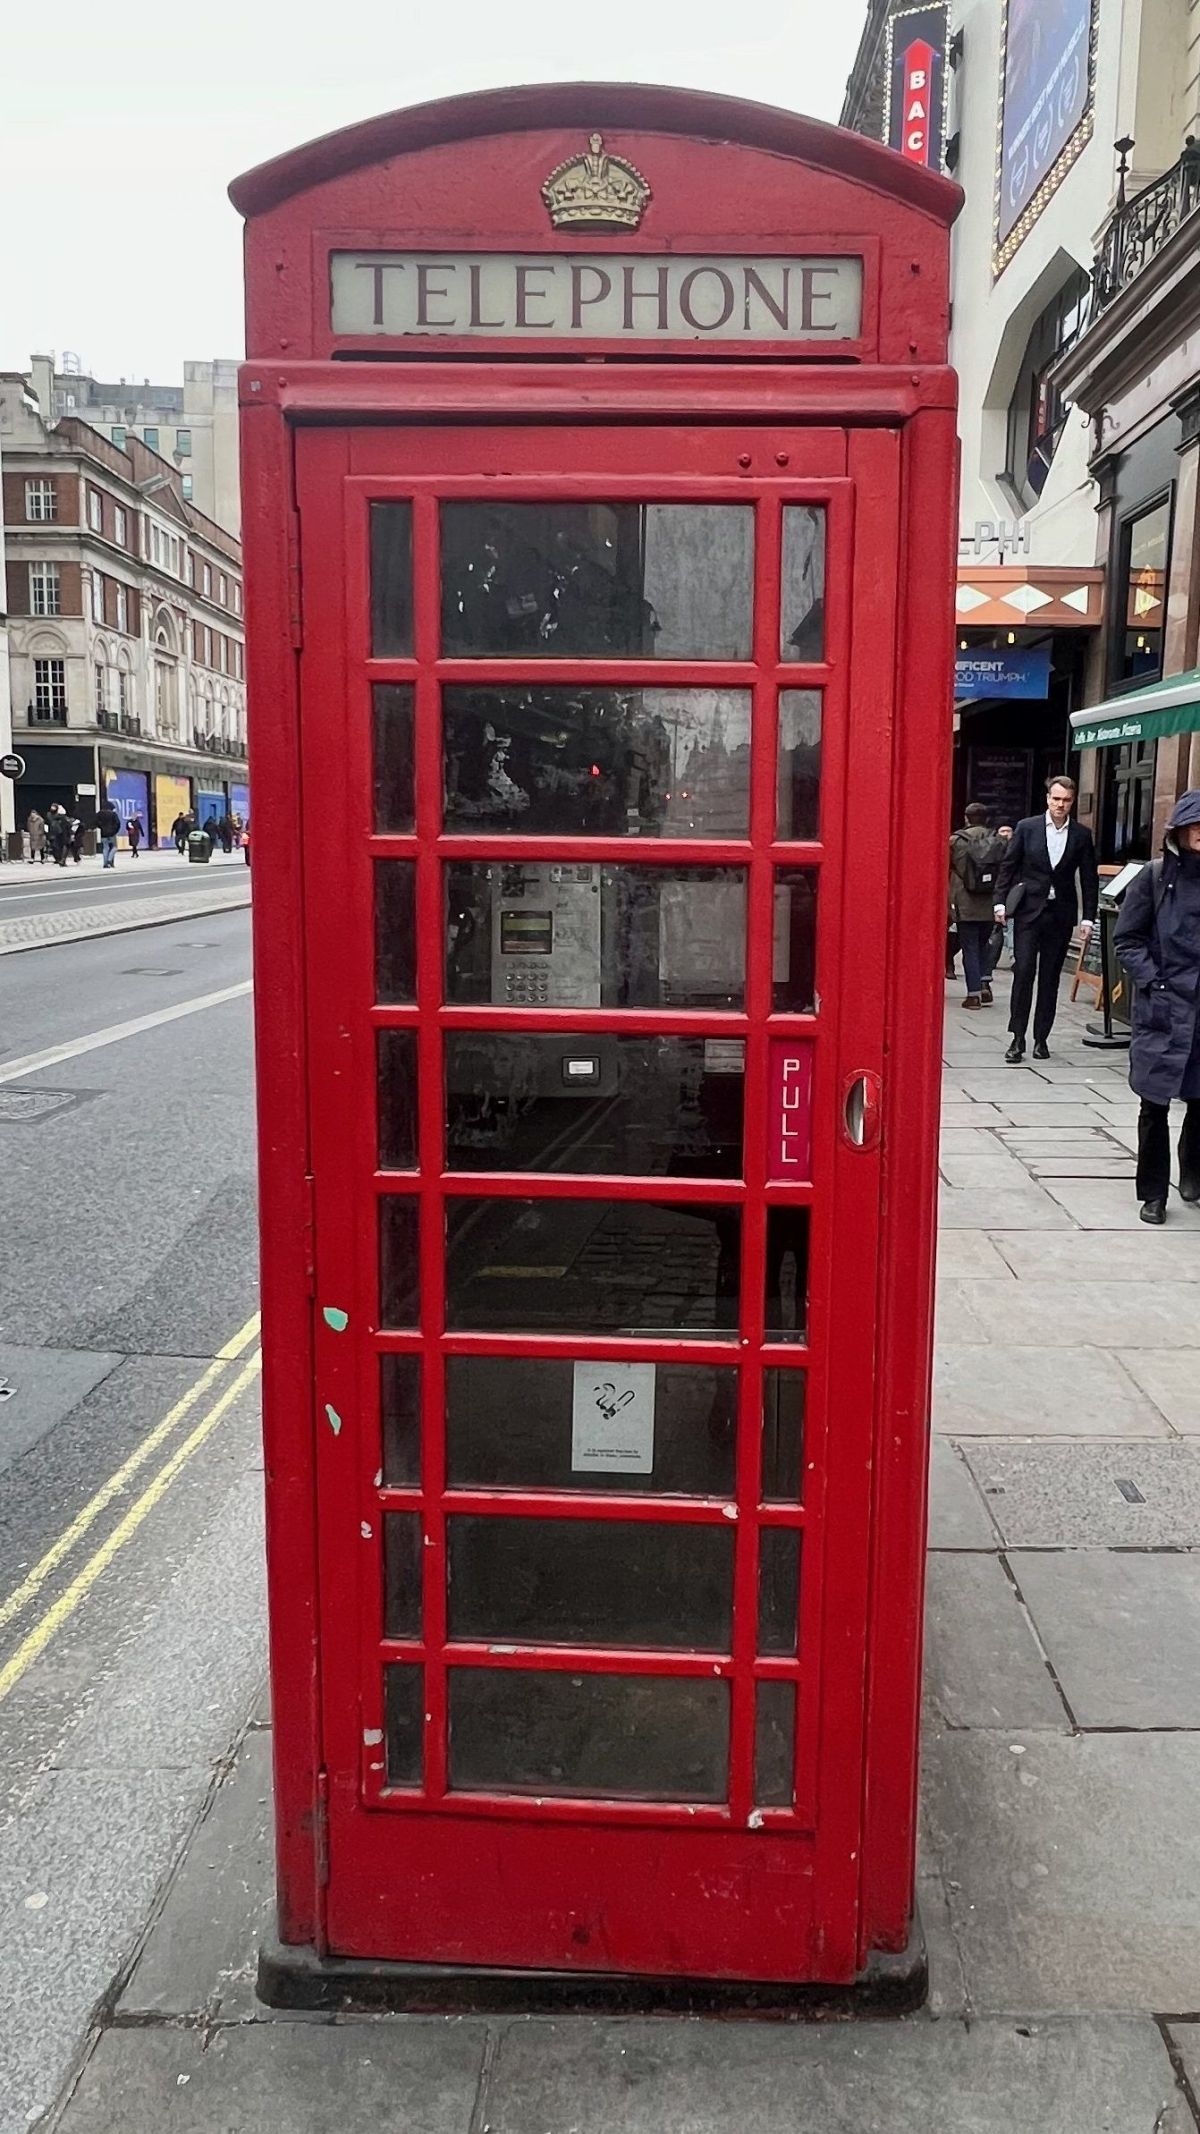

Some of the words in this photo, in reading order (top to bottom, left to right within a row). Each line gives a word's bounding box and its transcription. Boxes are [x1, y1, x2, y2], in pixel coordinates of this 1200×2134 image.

[907, 70, 926, 164] BAC
[354, 262, 841, 332] TELEPHONE
[782, 1059, 800, 1162] PULL
